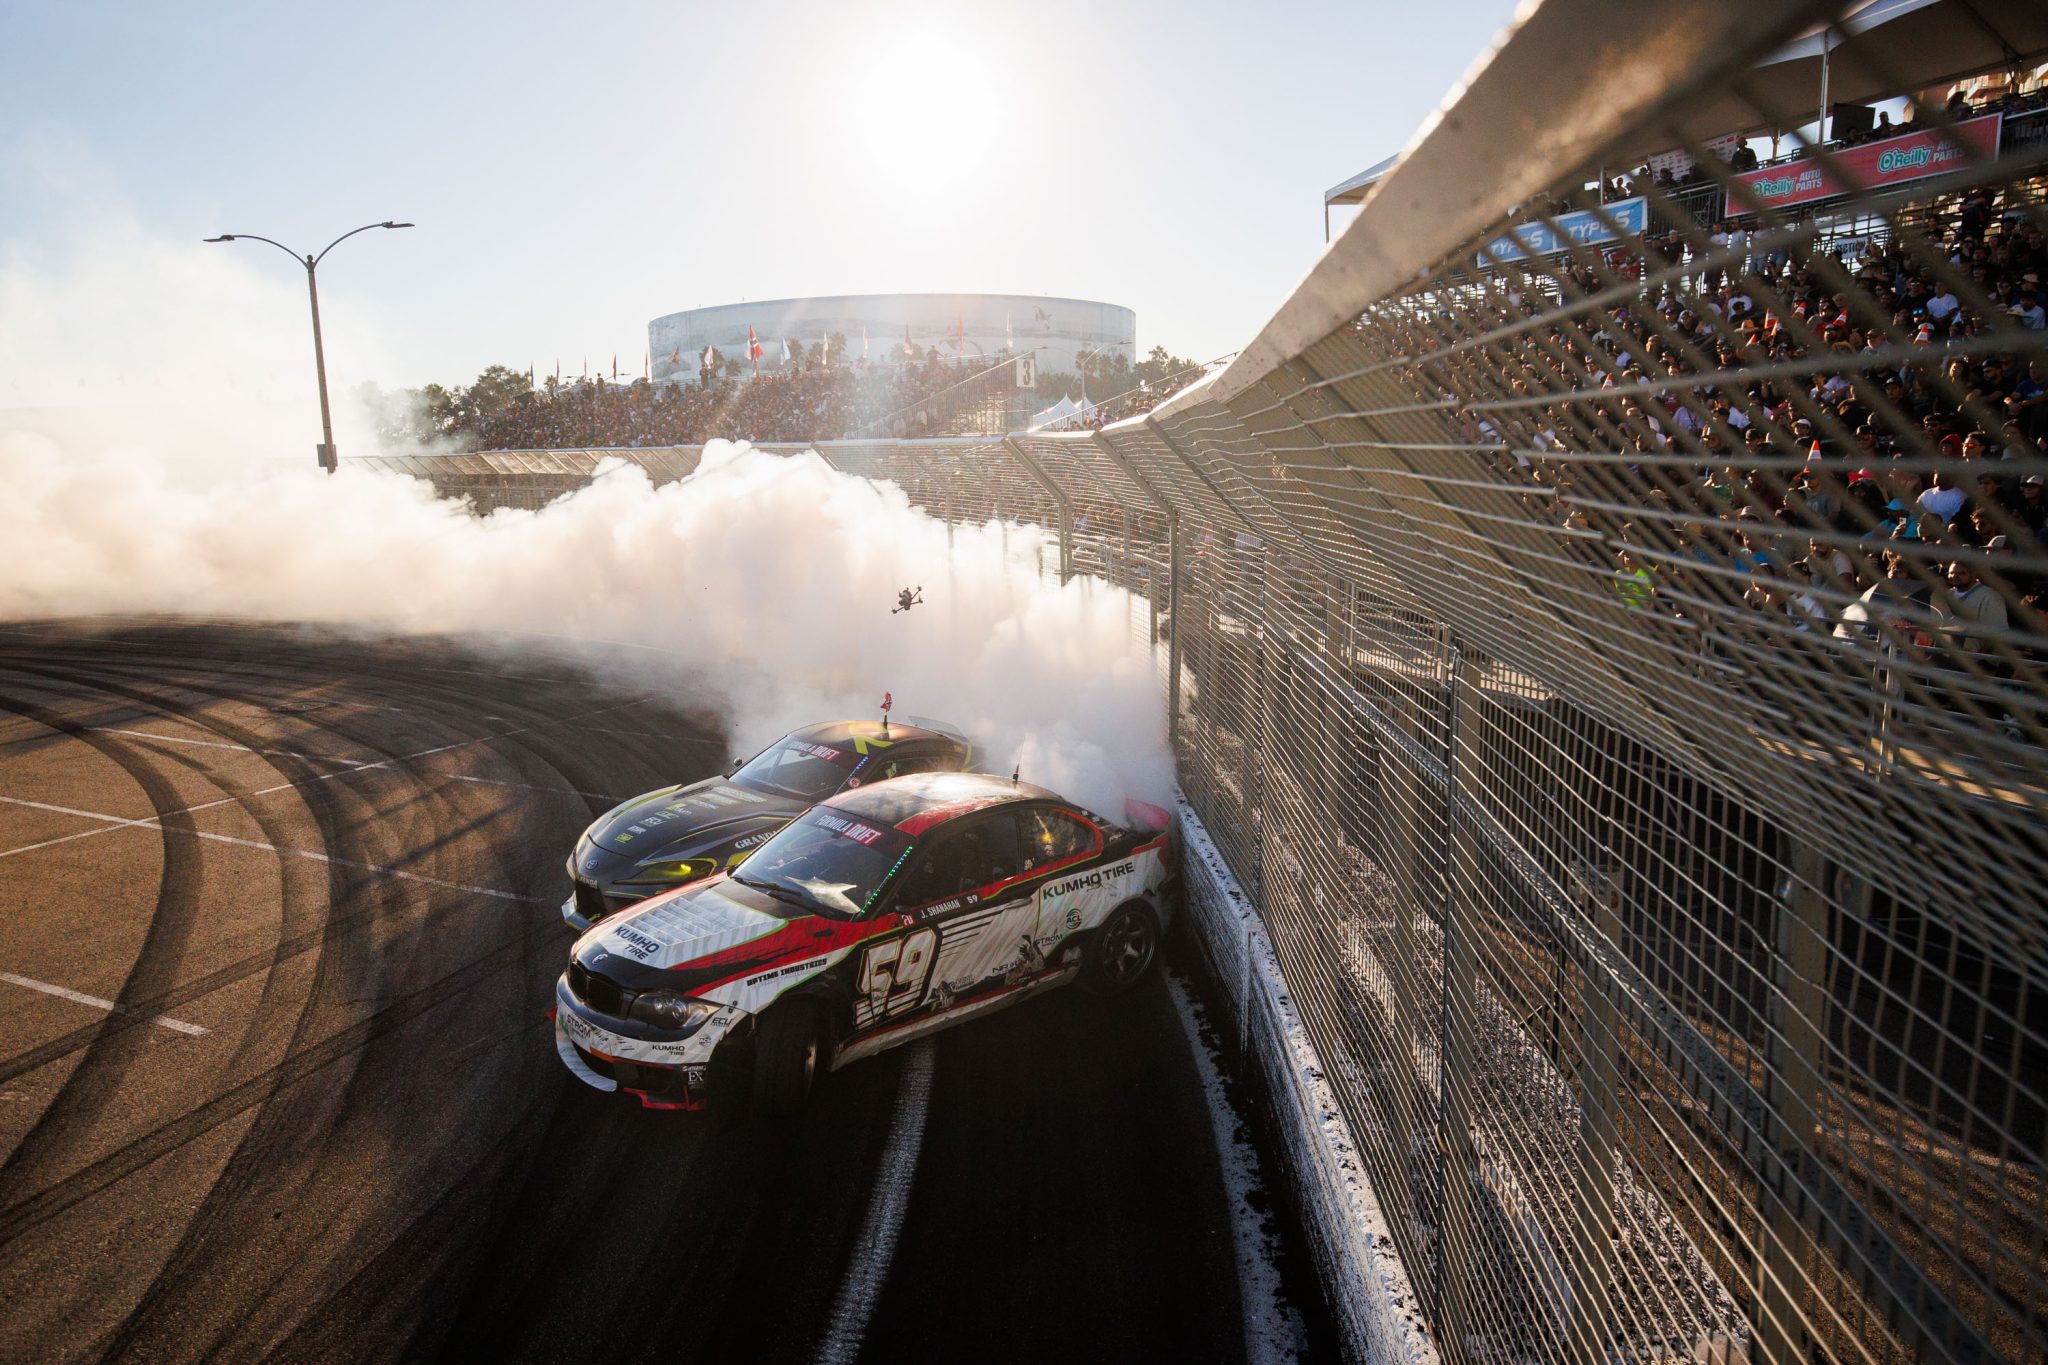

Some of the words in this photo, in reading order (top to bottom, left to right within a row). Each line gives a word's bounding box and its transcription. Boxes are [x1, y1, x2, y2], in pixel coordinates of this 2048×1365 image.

[1878, 146, 1933, 174] O'Reilly
[1752, 176, 1796, 197] O'Reilly
[1795, 178, 1823, 192] PARTS
[1799, 169, 1821, 183] AUTO
[1614, 209, 1632, 229] S
[1530, 229, 1544, 248] S
[1022, 360, 1031, 386] 3
[811, 744, 841, 761] DRIFT
[815, 814, 854, 833] FORMULA
[845, 823, 882, 844] DRIFT
[1043, 871, 1103, 900] KUMHO
[1103, 861, 1135, 881] TIRE
[920, 909, 929, 919] J.
[926, 899, 961, 917] SHANAHAN
[966, 894, 978, 904] 59
[614, 926, 660, 954] KUMHO
[624, 943, 649, 960] TIRE
[746, 970, 779, 987] UPTIME
[780, 957, 828, 976] INDUSTRIES
[854, 926, 937, 1030] 59
[651, 1044, 686, 1052] KUMHO
